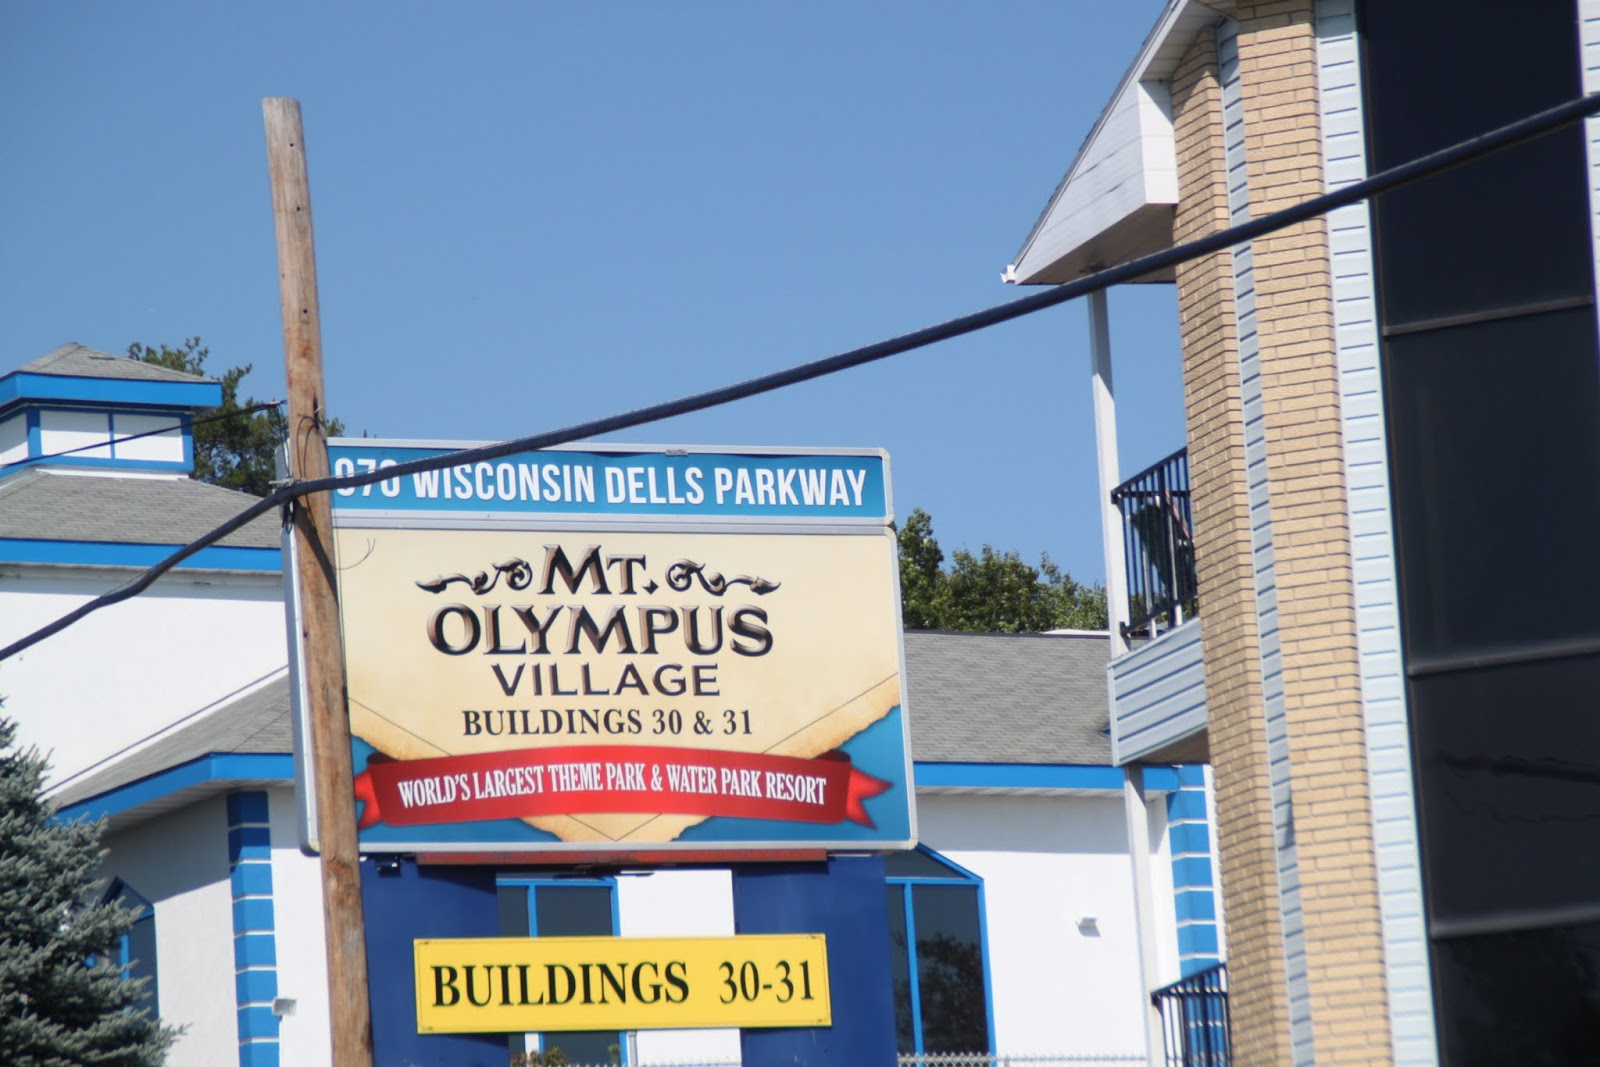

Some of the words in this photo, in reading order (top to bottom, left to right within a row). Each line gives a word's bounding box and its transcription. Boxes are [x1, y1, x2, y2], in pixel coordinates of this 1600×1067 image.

[411, 461, 595, 503] WISCONSIN
[605, 467, 704, 505] DELLS
[714, 467, 866, 506] PARKWAY
[427, 603, 774, 657] OLYMPUS
[490, 663, 720, 697] VILLAGE
[462, 709, 643, 736] BUILDINGS
[652, 709, 682, 735] 30
[693, 710, 714, 735] &
[723, 709, 753, 735] 31
[398, 773, 471, 808] WORLD'S
[472, 765, 544, 800] LARGEST
[548, 763, 603, 793] THEME
[605, 762, 646, 791] PARK
[651, 763, 663, 791] &
[666, 764, 718, 794] WATER
[720, 767, 762, 798] PARK
[765, 771, 827, 805] RESORT
[431, 960, 690, 1007] BUILDINGS
[718, 960, 815, 1004] 30-31
